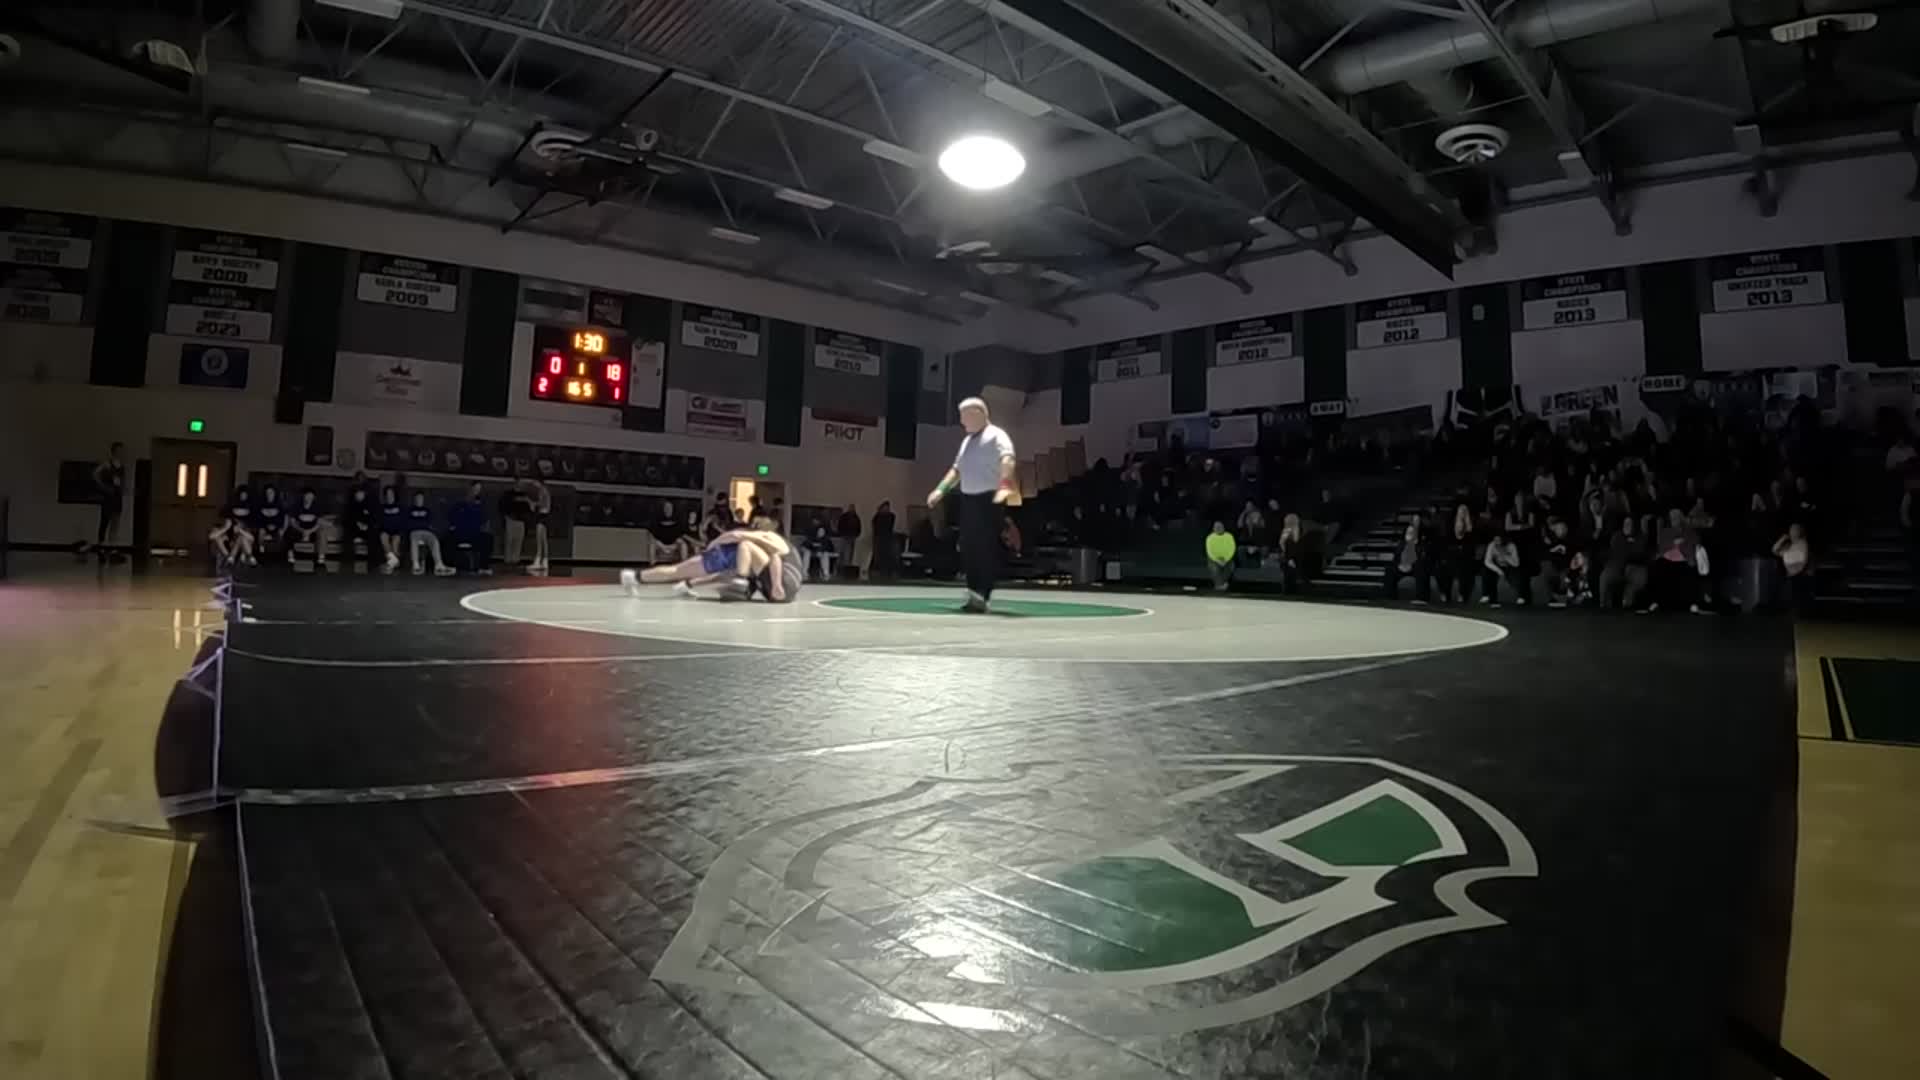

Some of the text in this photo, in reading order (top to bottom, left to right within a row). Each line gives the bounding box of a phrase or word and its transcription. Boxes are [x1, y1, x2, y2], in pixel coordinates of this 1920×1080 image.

[1746, 289, 1793, 306] 2013
[1554, 308, 1595, 324] 2013
[574, 332, 604, 353] 1:30
[1384, 328, 1419, 343] 2012
[550, 356, 562, 375] 0
[606, 363, 622, 382] 18
[537, 377, 549, 393] 2
[614, 386, 620, 400] 1
